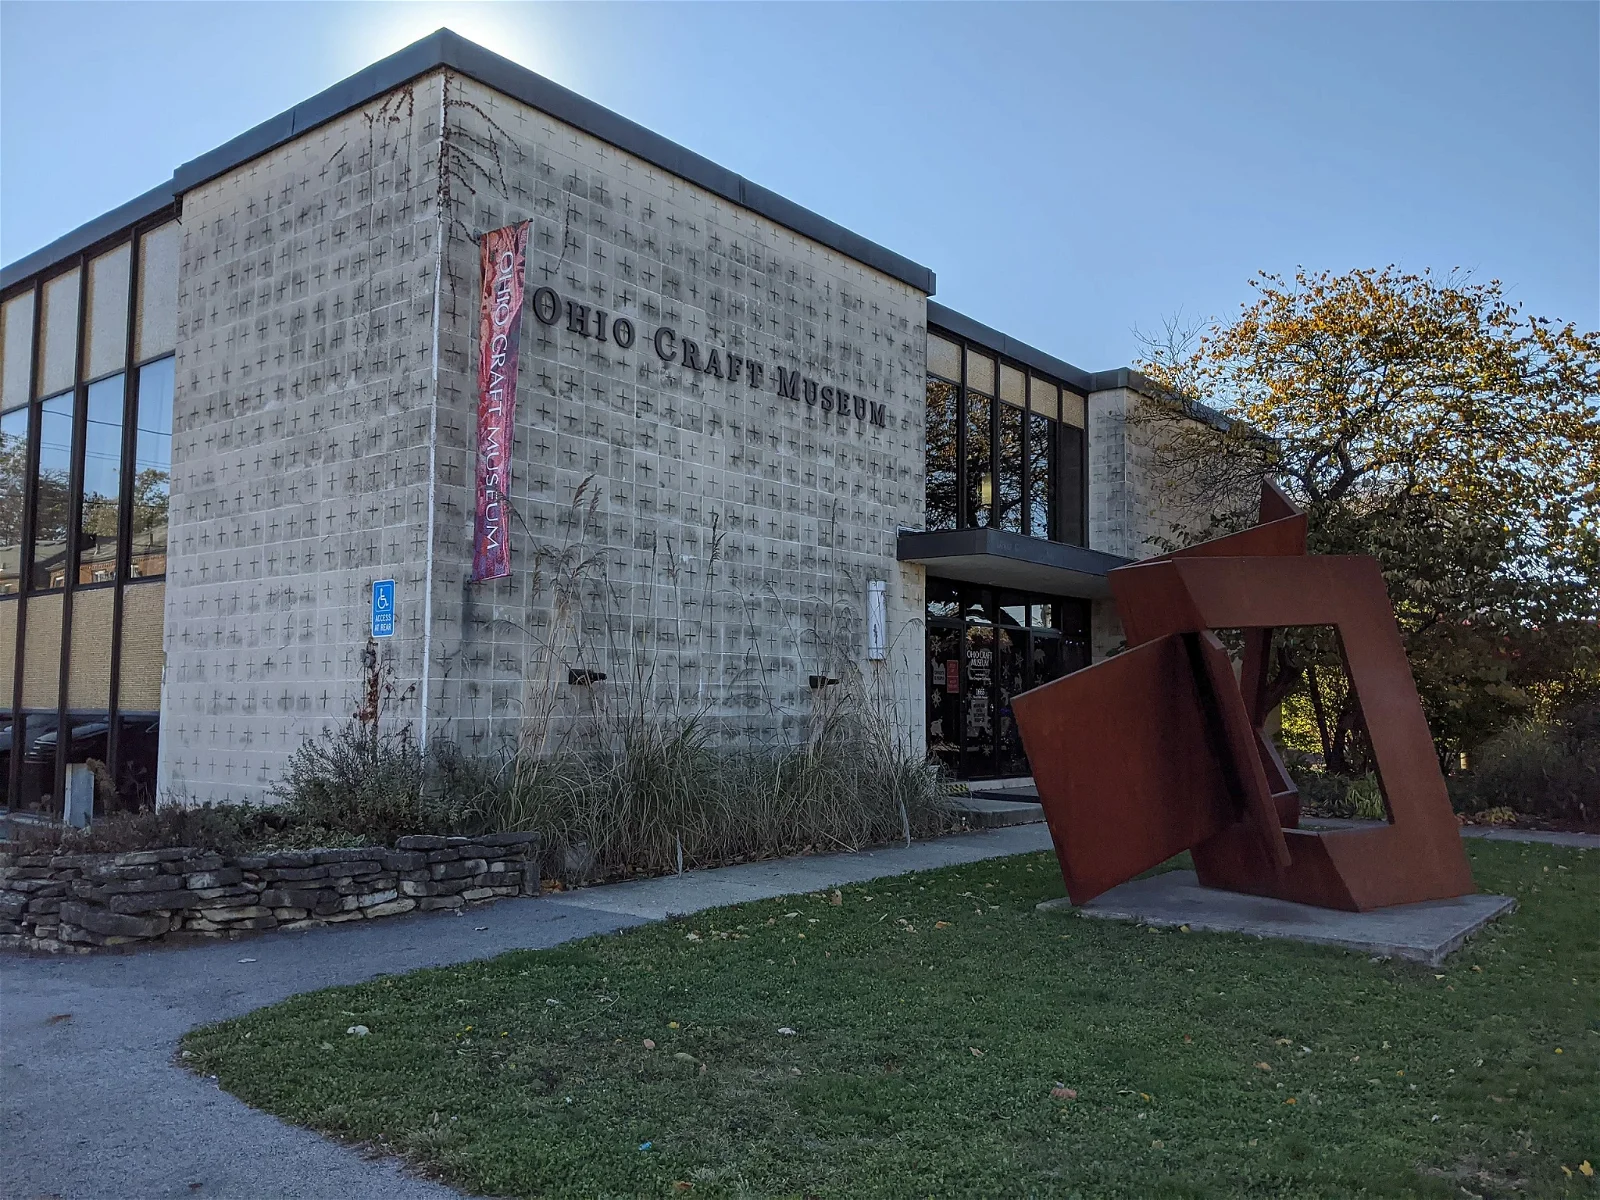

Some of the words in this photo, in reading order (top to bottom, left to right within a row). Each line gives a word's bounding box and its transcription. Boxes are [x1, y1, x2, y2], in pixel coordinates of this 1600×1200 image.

[494, 251, 514, 326] OHIO
[488, 333, 508, 417] CRAFT
[532, 286, 636, 350] OHIO
[654, 326, 765, 389] CRAFT
[776, 365, 887, 429] MUSEUM
[485, 427, 500, 550] MUSEUM
[374, 624, 380, 632] AT
[380, 623, 392, 631] REAR
[375, 614, 392, 623] ACCESS
